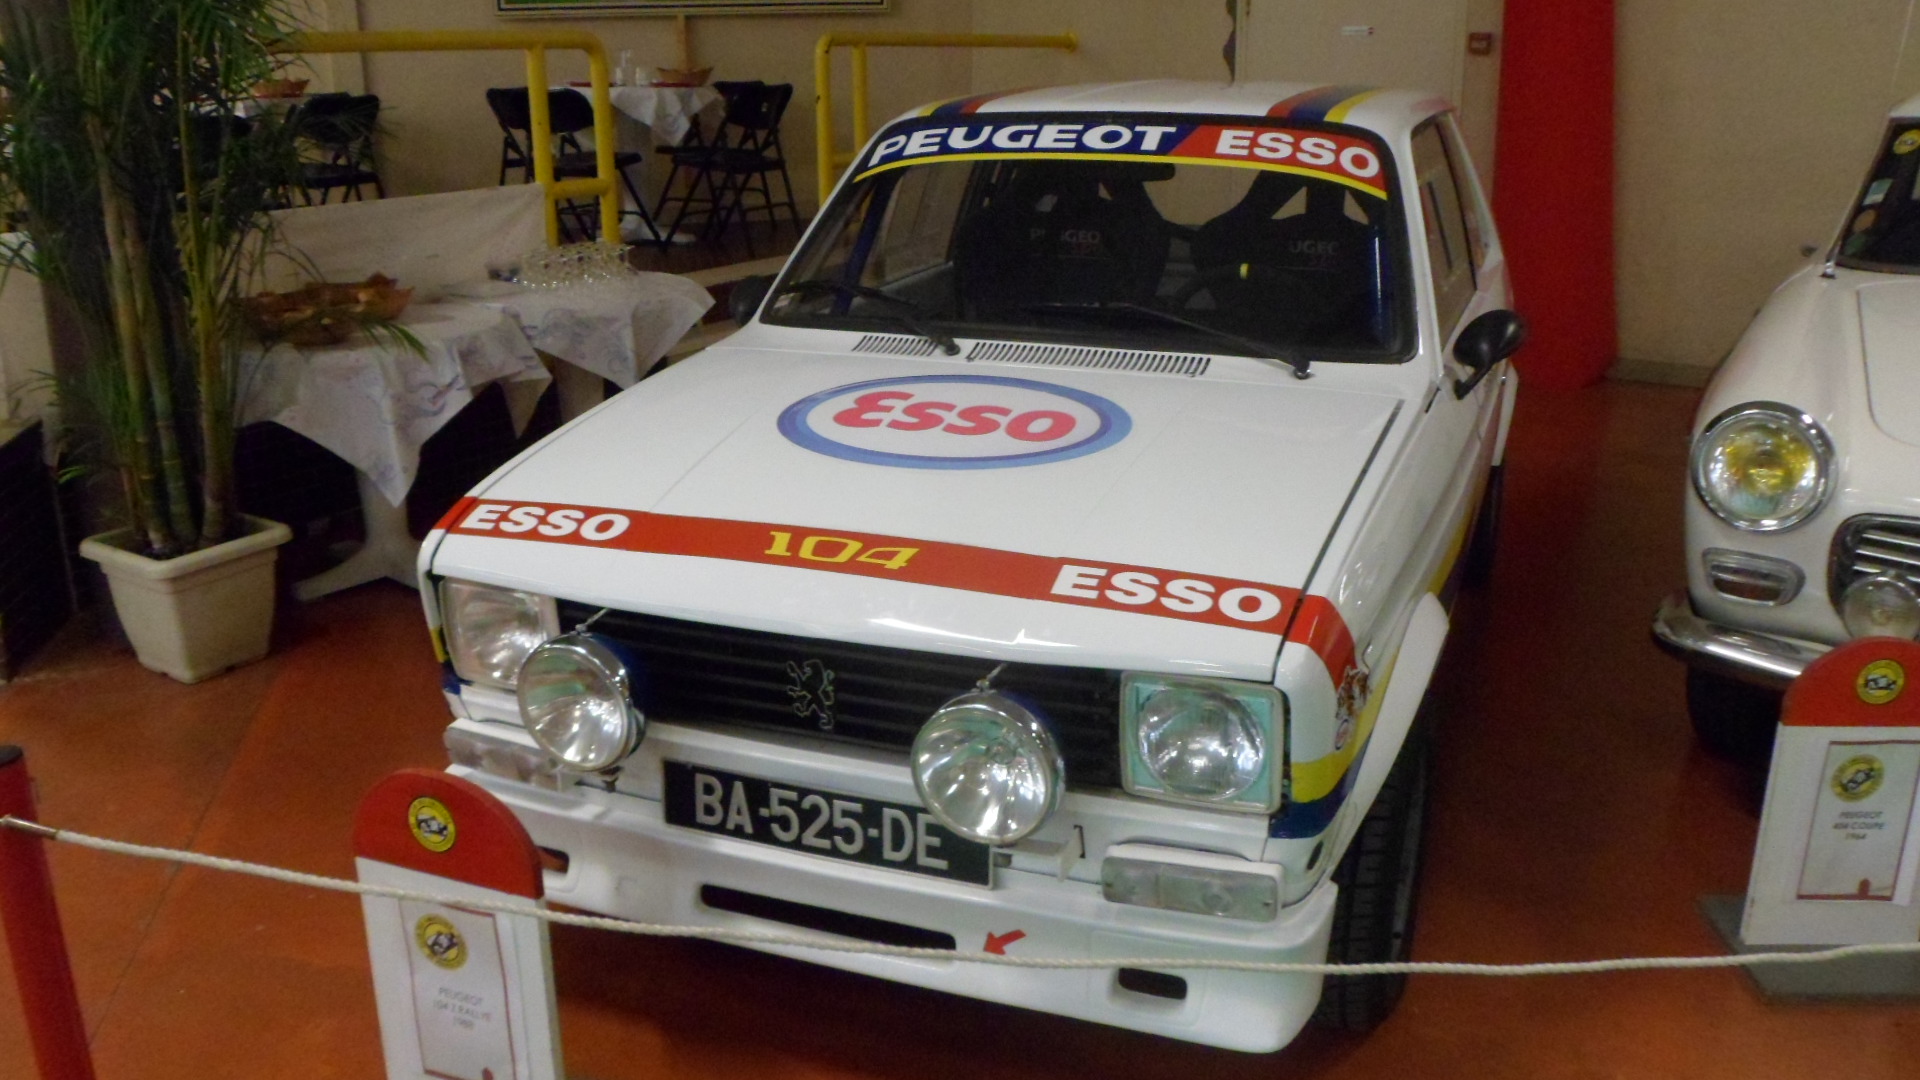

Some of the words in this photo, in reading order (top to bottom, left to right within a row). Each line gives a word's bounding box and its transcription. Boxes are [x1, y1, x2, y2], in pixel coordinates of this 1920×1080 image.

[868, 124, 1178, 168] PEUGEOT
[1215, 130, 1381, 178] ESSO
[459, 503, 631, 542] ESSO
[765, 530, 920, 570] 104
[1050, 564, 1282, 622] ESSO
[694, 773, 949, 870] BA-525-DE
